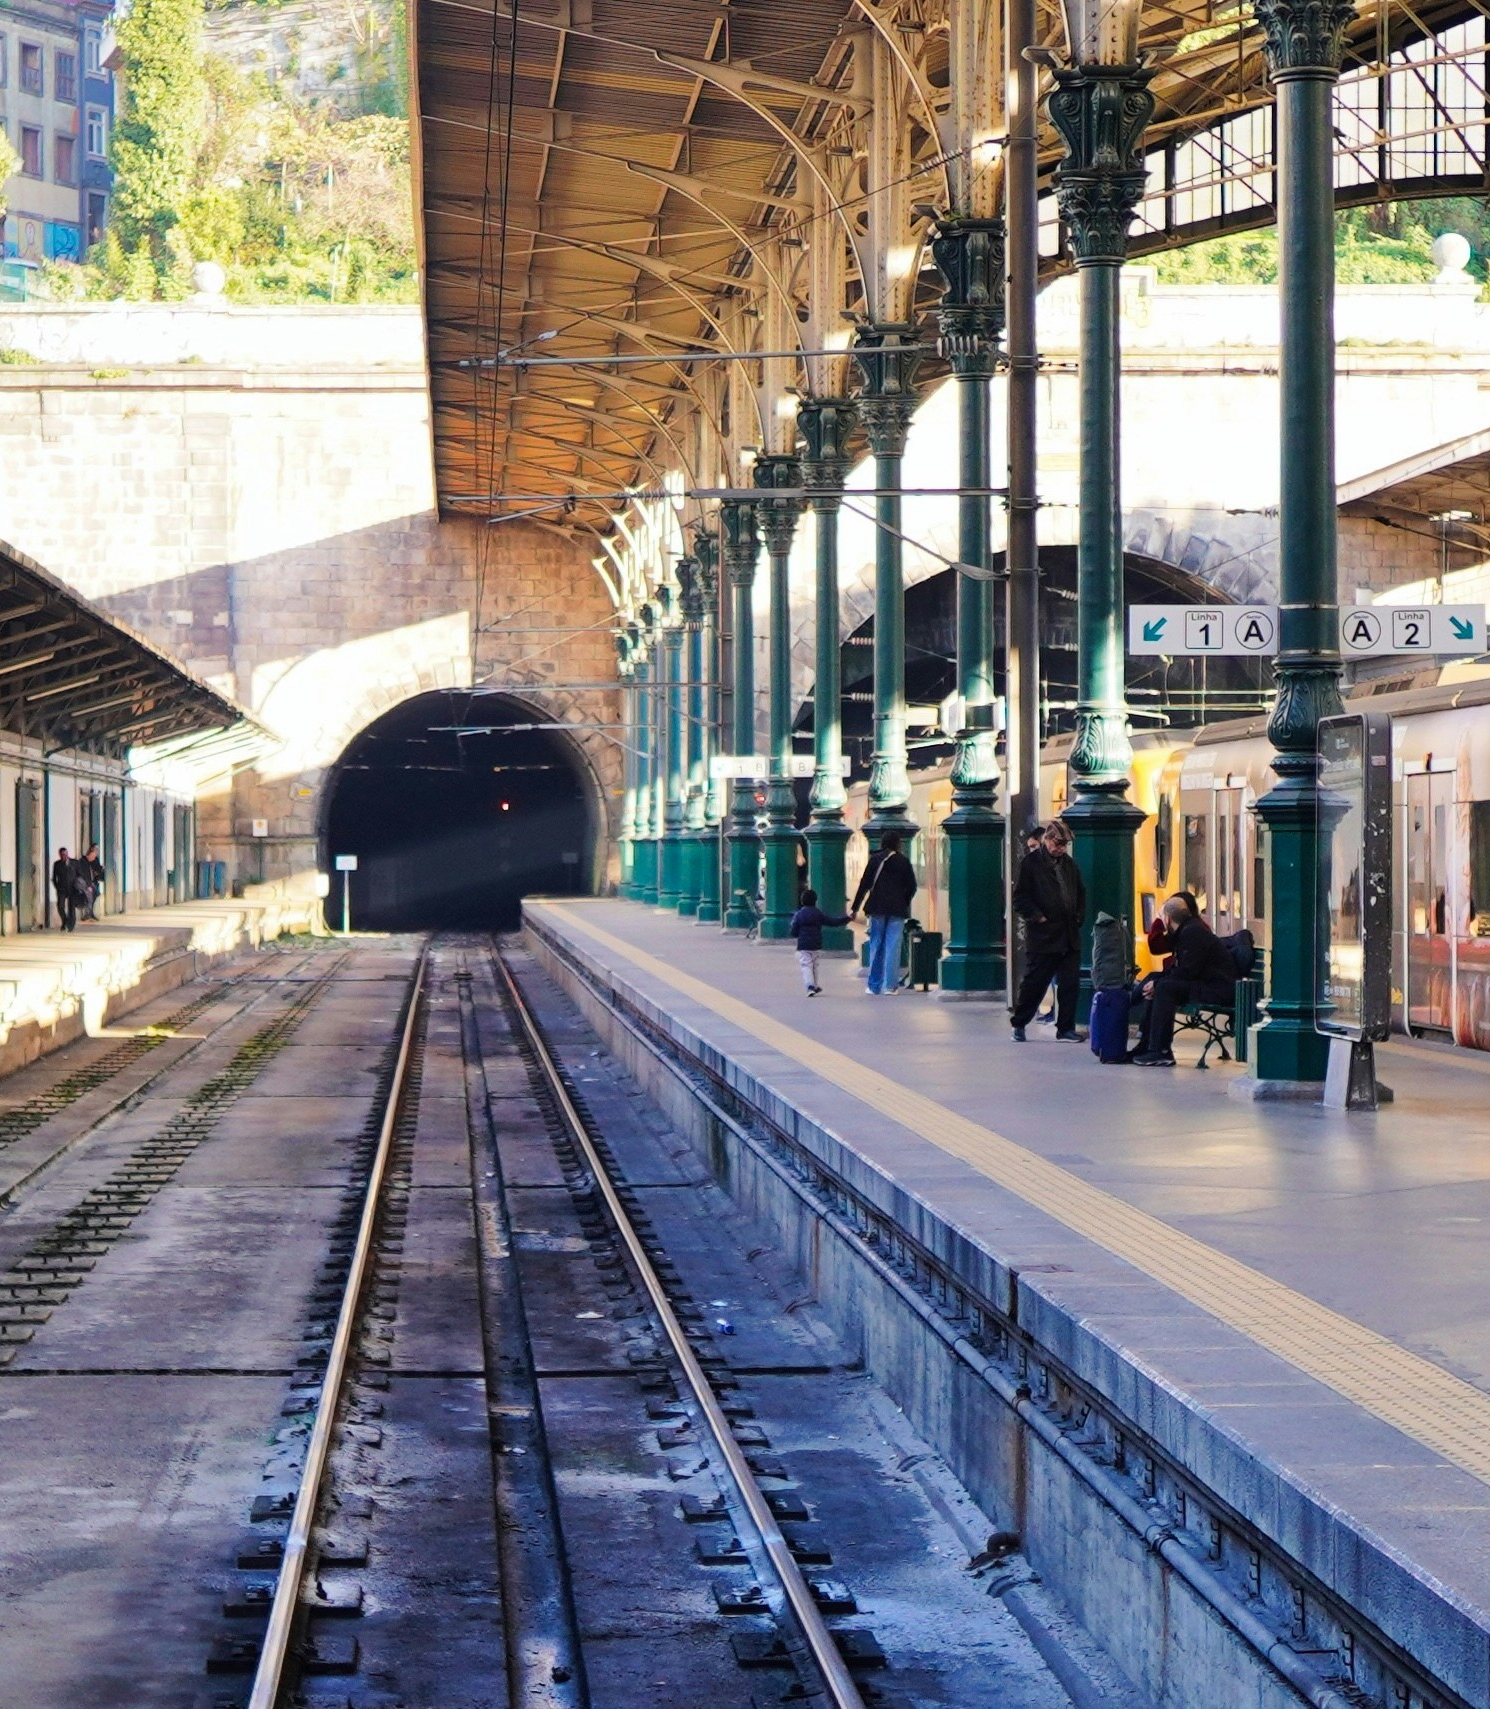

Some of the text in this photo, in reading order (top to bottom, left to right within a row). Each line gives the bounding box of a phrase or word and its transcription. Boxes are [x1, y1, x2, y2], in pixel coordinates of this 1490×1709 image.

[1191, 613, 1218, 621] Linha
[1398, 612, 1425, 620] Linha
[1199, 623, 1210, 646] 1
[1243, 620, 1265, 642] A
[1351, 620, 1373, 642] A
[1405, 623, 1420, 645] 2
[755, 763, 764, 772] B
[798, 762, 807, 772] B
